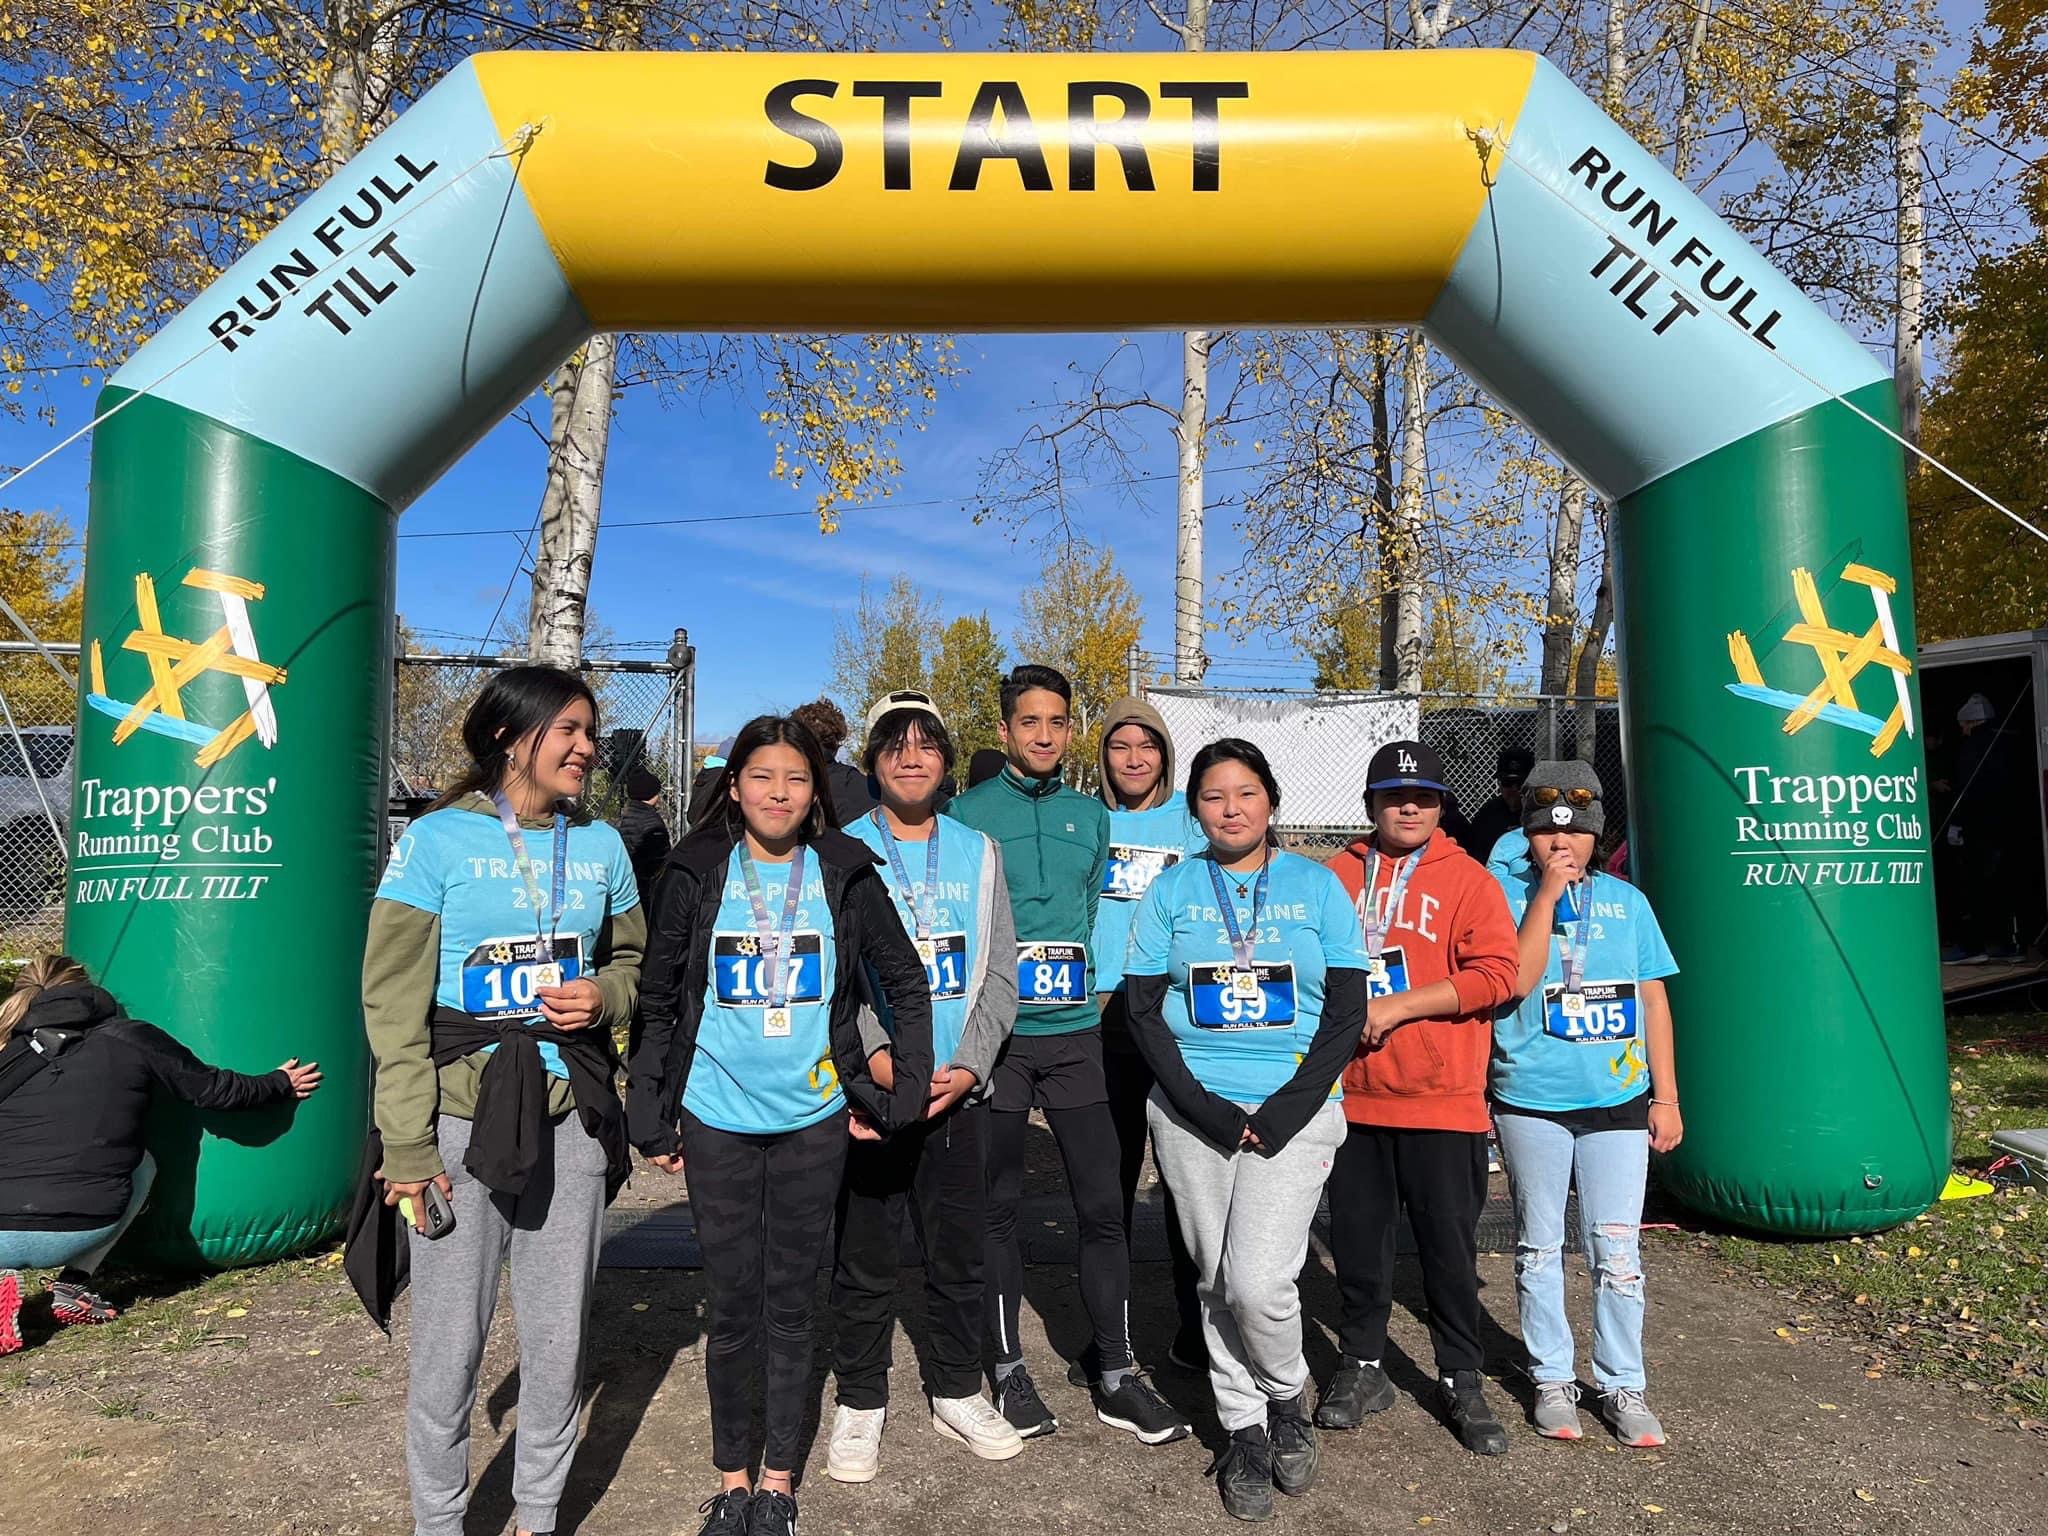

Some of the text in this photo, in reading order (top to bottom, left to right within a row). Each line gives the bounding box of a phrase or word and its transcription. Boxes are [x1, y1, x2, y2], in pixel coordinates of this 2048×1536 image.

[764, 79, 1249, 191] START
[208, 154, 438, 352] RUN FULL
[1568, 146, 1782, 351] RUN FULL
[303, 231, 416, 336] TILT
[1589, 235, 1700, 336] TILT
[1397, 749, 1418, 773] LA
[82, 777, 277, 827] Trappers'
[1734, 766, 1918, 814] Trappers'
[77, 825, 273, 860] Running Club
[1736, 812, 1922, 846] Running Club
[555, 835, 565, 871] Running
[76, 876, 269, 903] RUN FULL TILT
[1743, 862, 1924, 886] RUN FULL TILT
[1033, 963, 1072, 996] 84
[1584, 987, 1617, 995] TRAPLINE
[1220, 986, 1267, 1022] 99
[1566, 1002, 1626, 1036] 105
